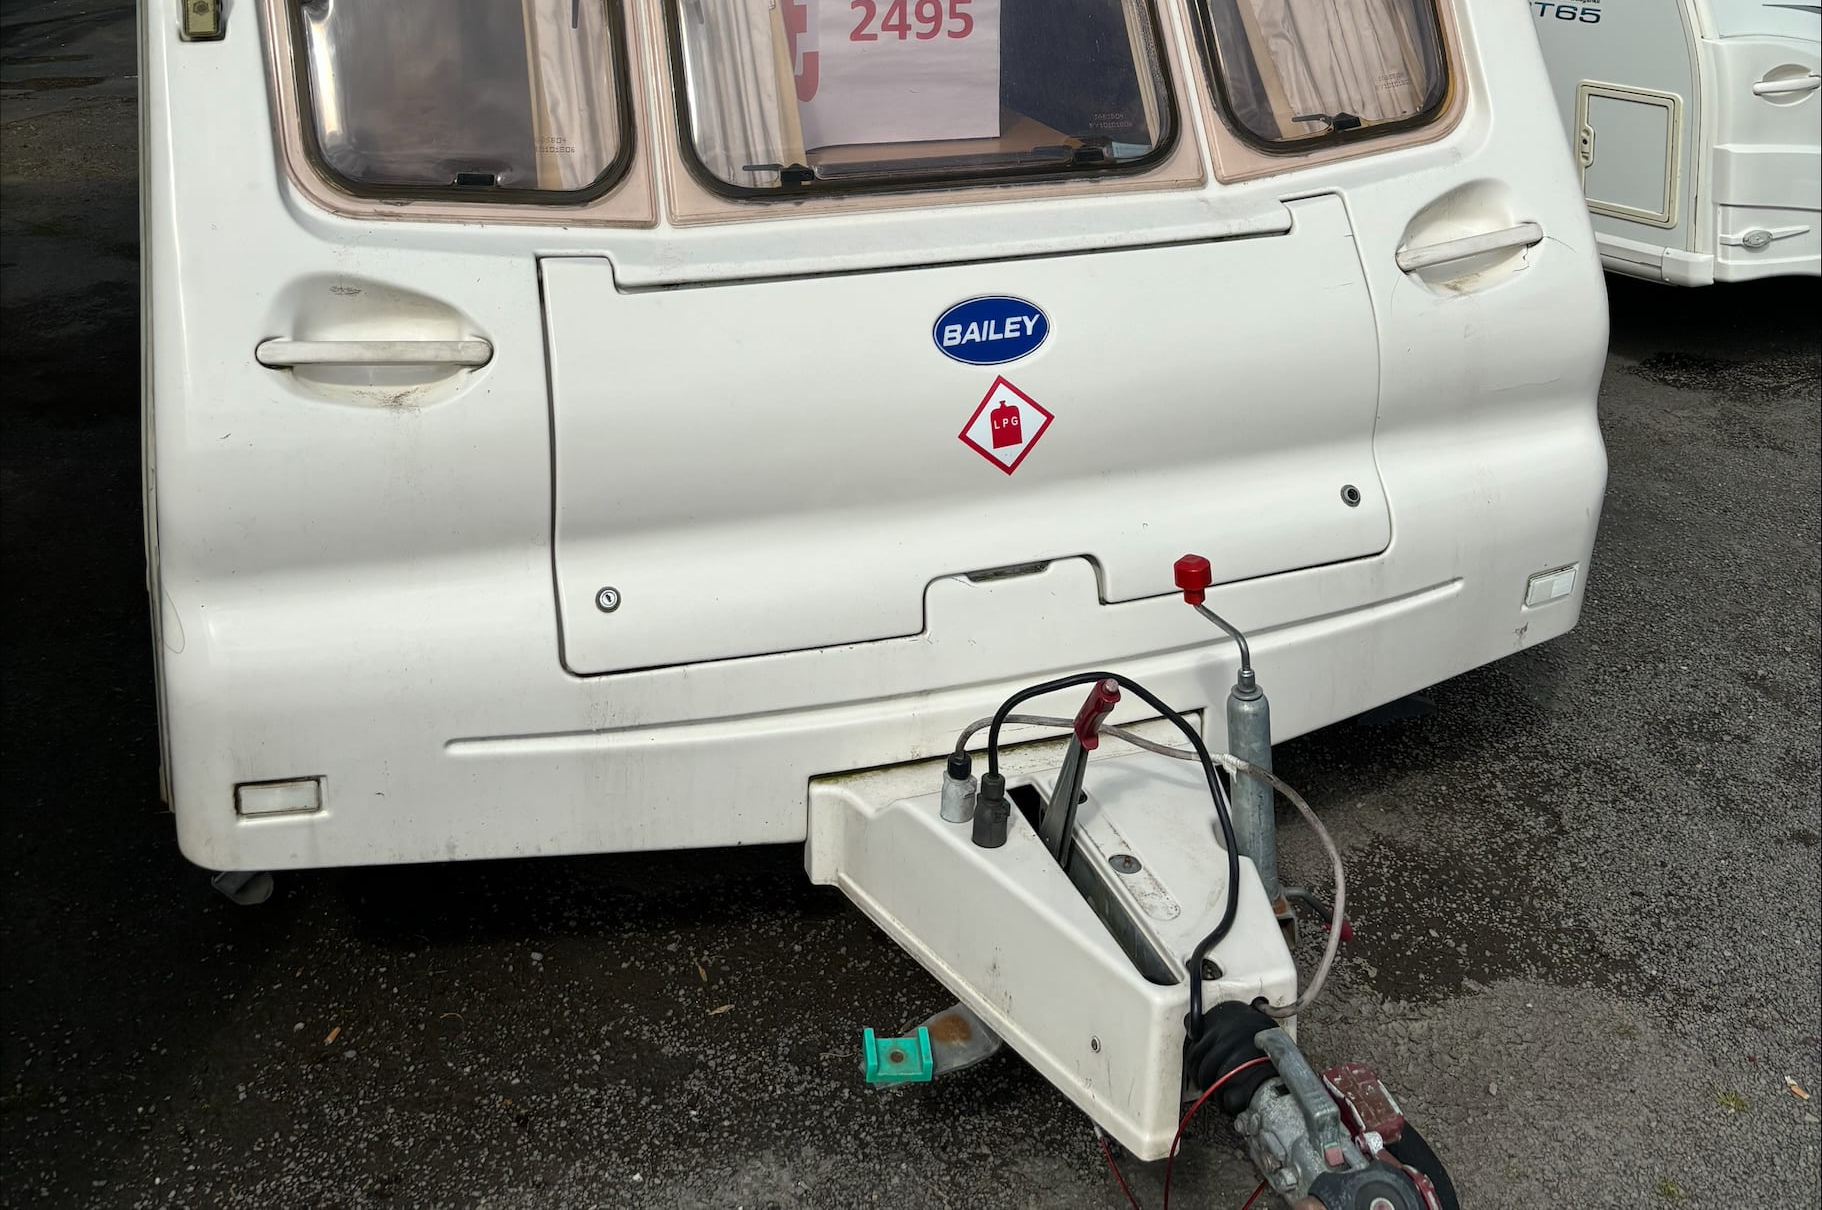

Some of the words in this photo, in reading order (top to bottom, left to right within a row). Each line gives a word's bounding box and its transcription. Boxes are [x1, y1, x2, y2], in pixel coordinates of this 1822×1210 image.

[1530, 1, 1602, 24] T65
[942, 313, 1041, 348] BAILEY
[993, 416, 1019, 430] LPG
